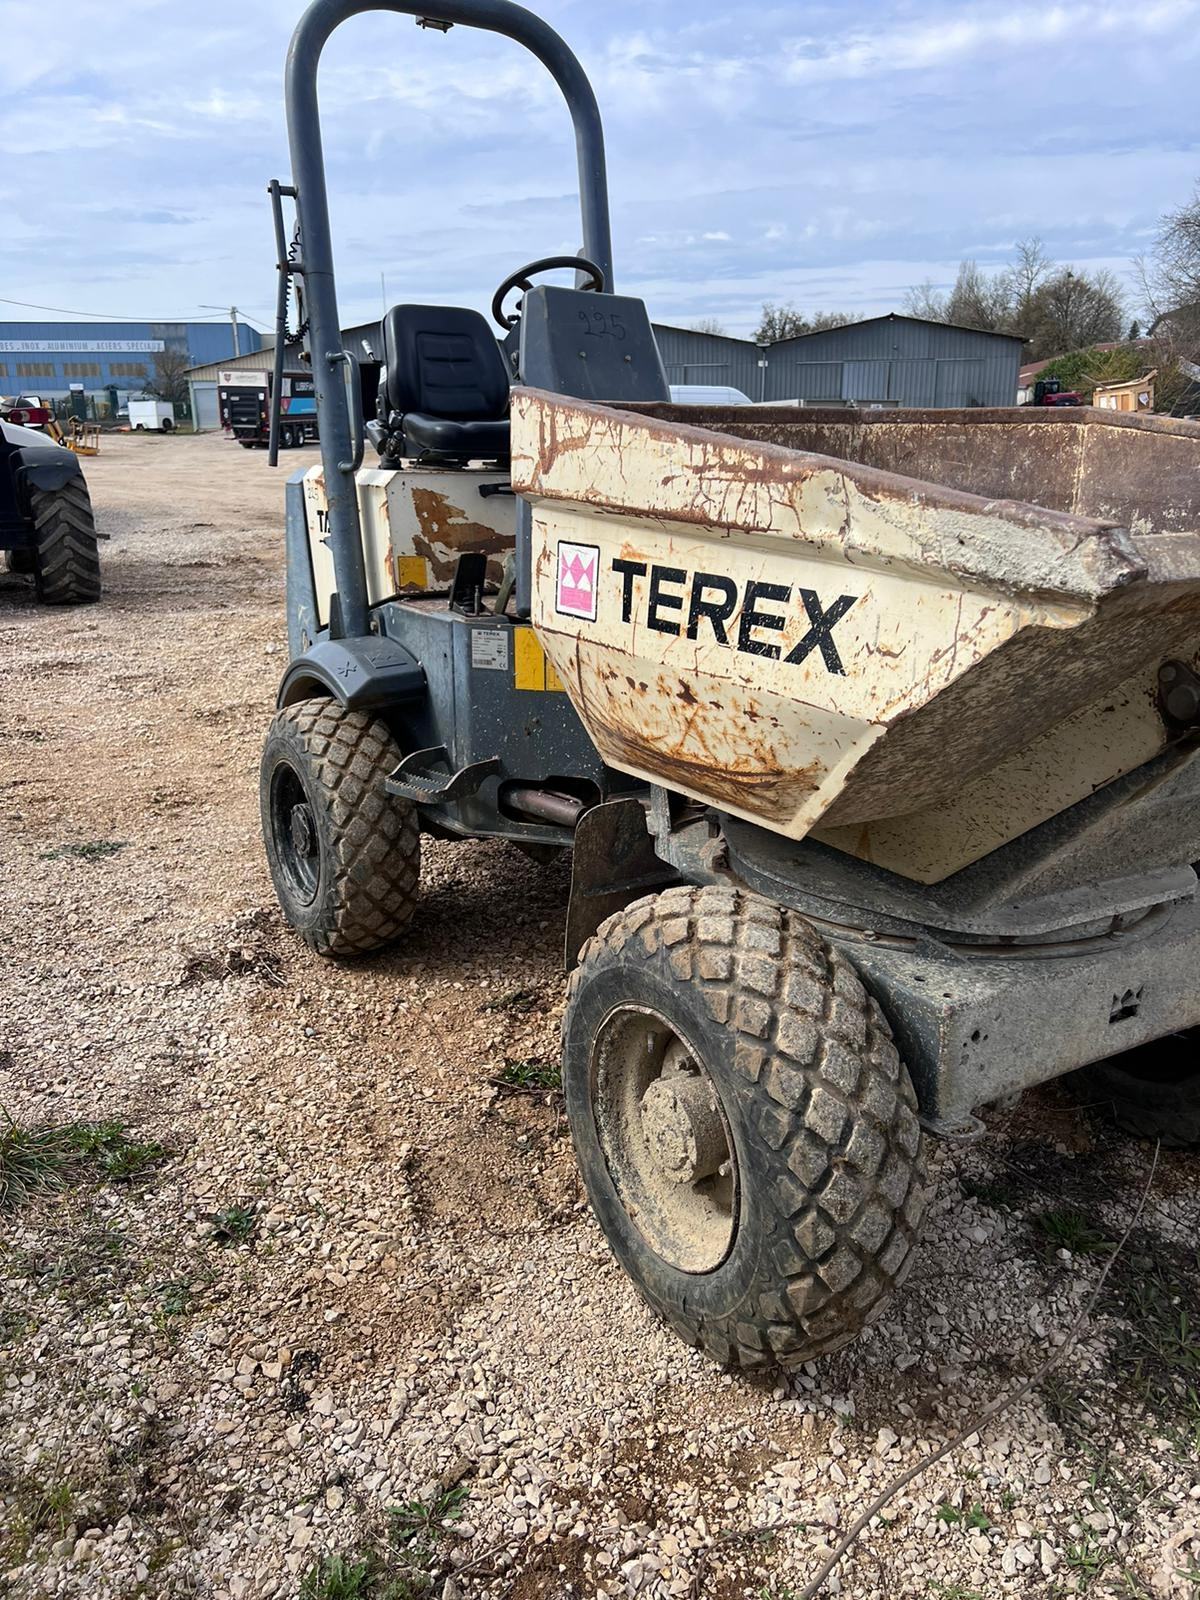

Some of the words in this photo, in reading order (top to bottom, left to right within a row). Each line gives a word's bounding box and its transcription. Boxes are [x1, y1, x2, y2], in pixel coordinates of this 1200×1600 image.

[578, 311, 626, 341] 225
[21, 342, 39, 350] INOX
[47, 342, 88, 350] ALUMINIUM
[96, 342, 122, 350] ACIERS
[127, 342, 161, 351] SPECIAUX
[612, 558, 859, 677] TEREX
